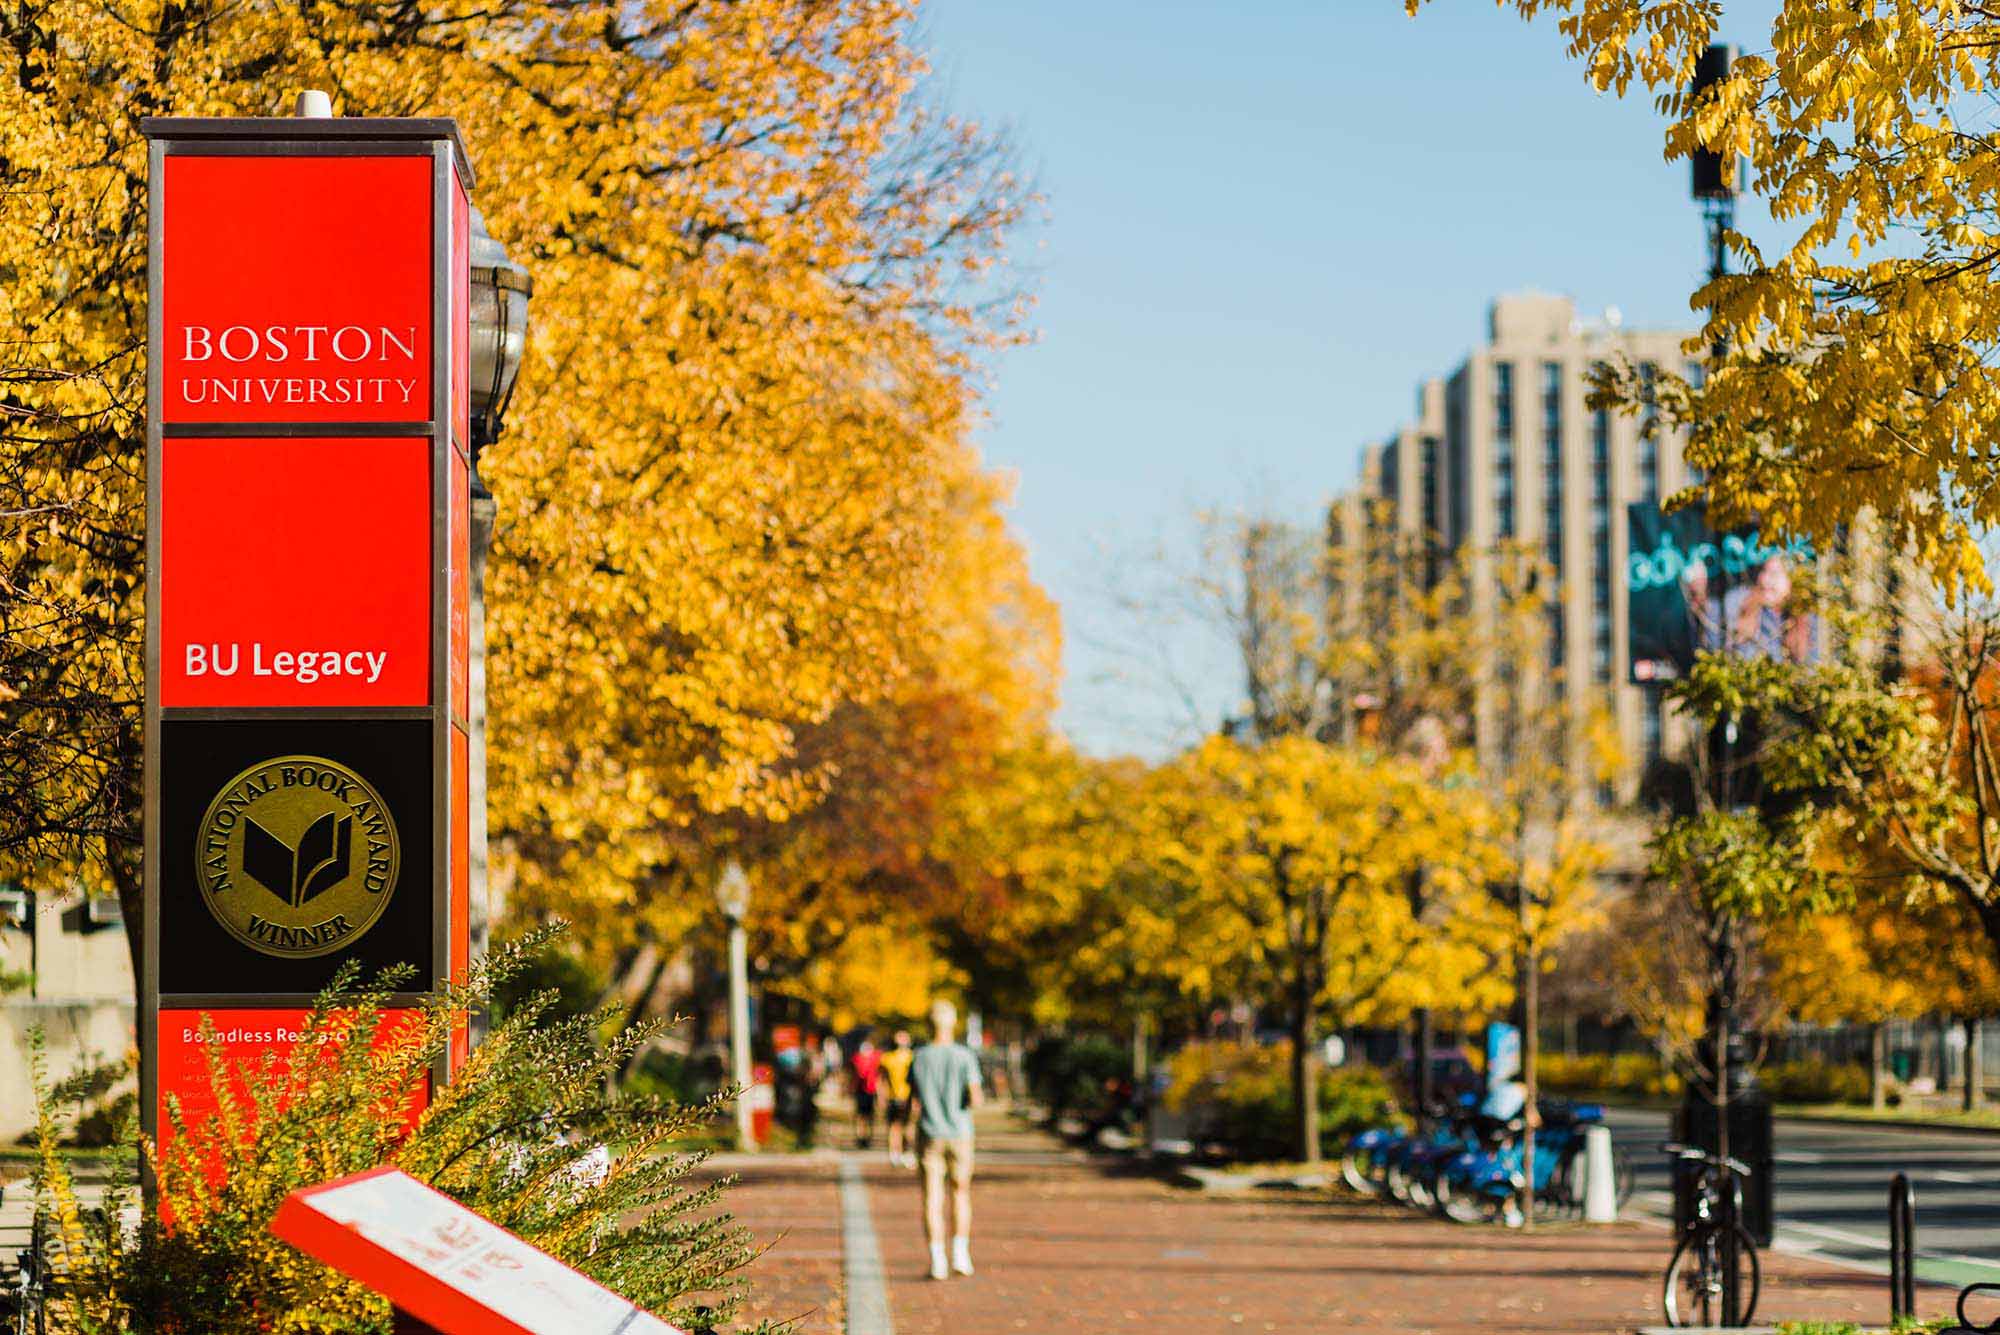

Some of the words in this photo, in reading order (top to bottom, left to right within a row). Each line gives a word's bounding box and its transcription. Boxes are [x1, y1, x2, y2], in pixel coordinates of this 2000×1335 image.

[182, 326, 416, 362] BOSTON
[183, 378, 417, 403] UNIVERSITY
[186, 643, 239, 676] BU
[253, 643, 387, 684] Legacy
[206, 770, 278, 894] NATIONAL
[280, 766, 358, 803] BOOK
[351, 799, 391, 894] AWARD
[249, 913, 353, 948] WINNER
